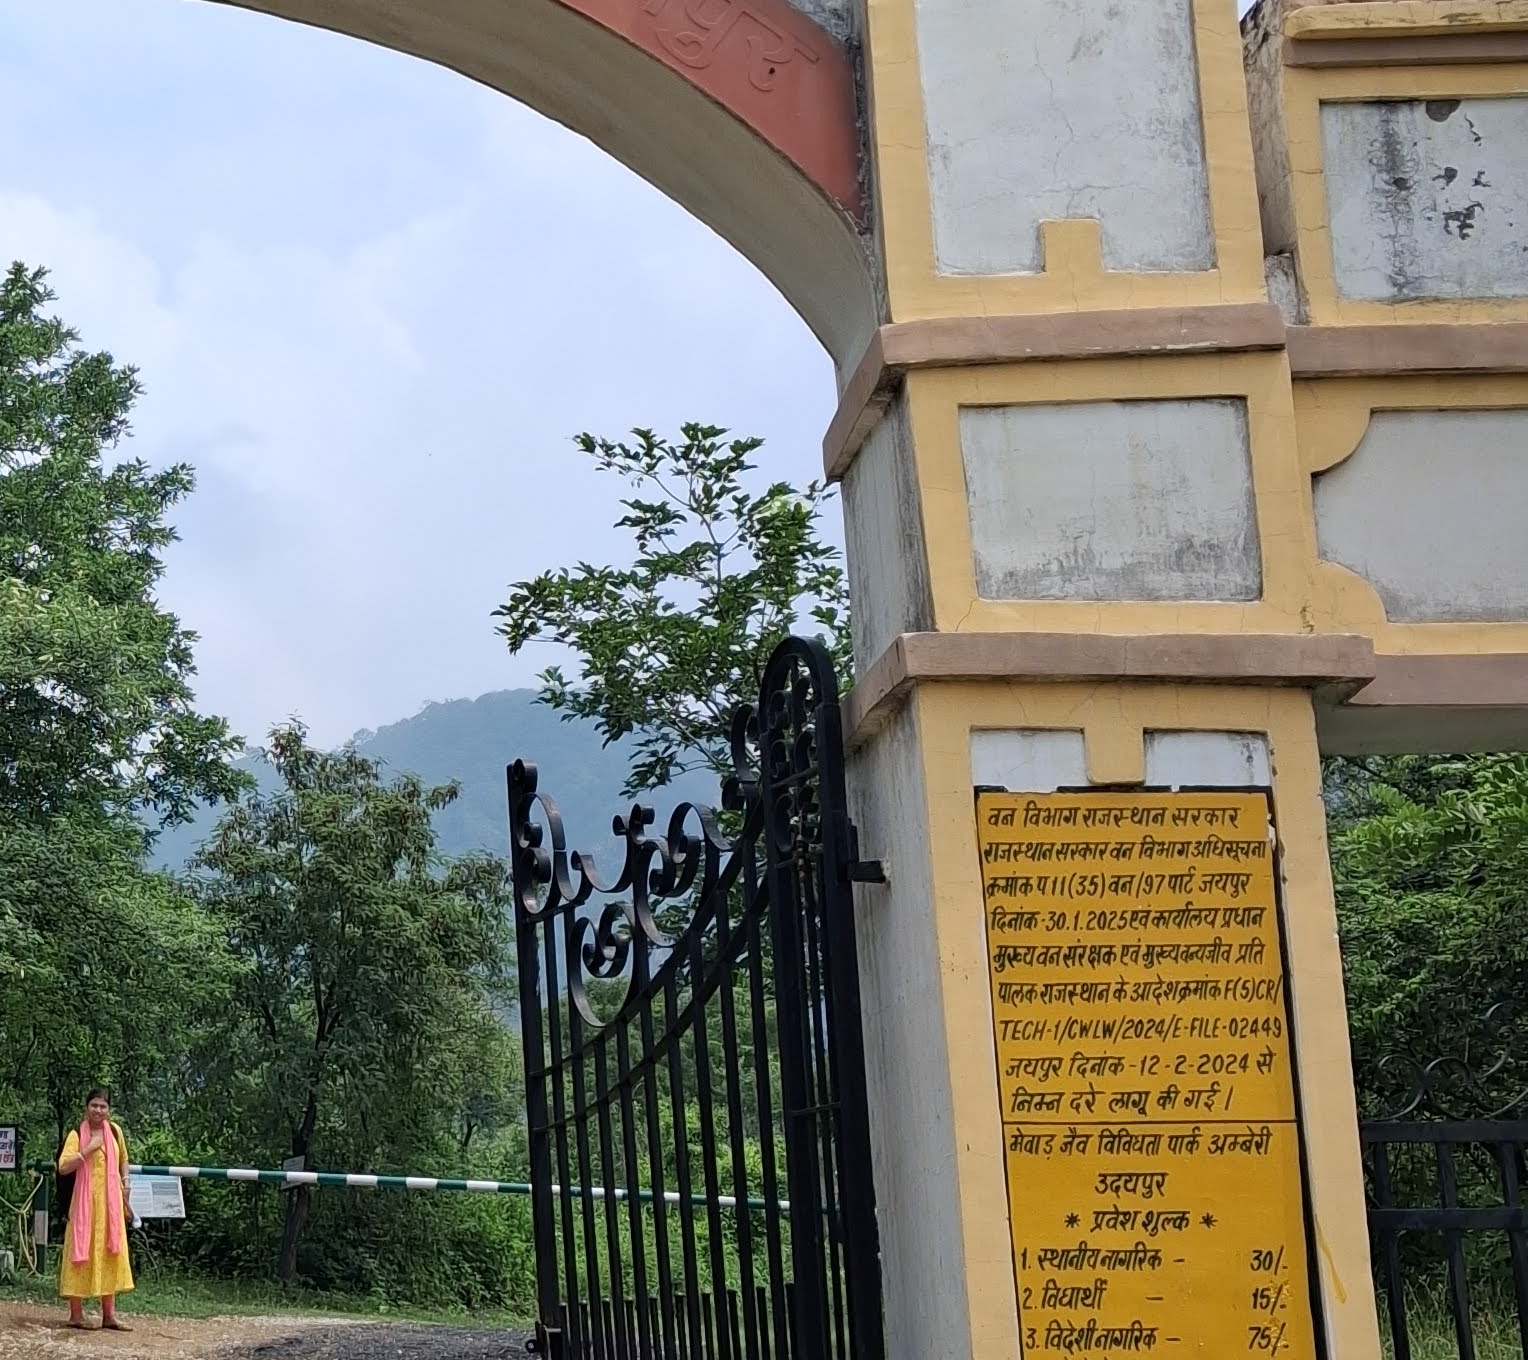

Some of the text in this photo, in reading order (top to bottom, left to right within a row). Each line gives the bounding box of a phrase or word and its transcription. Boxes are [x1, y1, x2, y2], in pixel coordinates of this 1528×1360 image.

[988, 800, 1241, 829] वन विभाग राजस्थान सरकार
[984, 834, 1266, 864] राजस्थान सरकार वन विभाग अधिसूचना
[987, 866, 1253, 898] क्रमांक पार्ट जयपुर
[1151, 901, 1267, 929] कार्यालय प्रधान
[993, 937, 1265, 972] मुख्य वन संरक्षक एवं प्रति
[998, 973, 1222, 1008] पालक राजस्थान आदेश क्रमांक
[1005, 1045, 1276, 1082] जयपुर से
[1011, 1083, 1181, 1116] निम्न दरे लागू की
[1010, 1125, 1273, 1160] मेवाड़ जैव विविधता पार्क अम्बेरी
[1094, 1172, 1170, 1199] उदयपुर
[1090, 1204, 1191, 1236] प्रवेश शुल्क
[1037, 1241, 1289, 1276] स्थानीय नागरिक 30/-
[1022, 1284, 1287, 1316] 2. 15/-
[1044, 1318, 1289, 1357] विदेशी नागरिक 75/-
